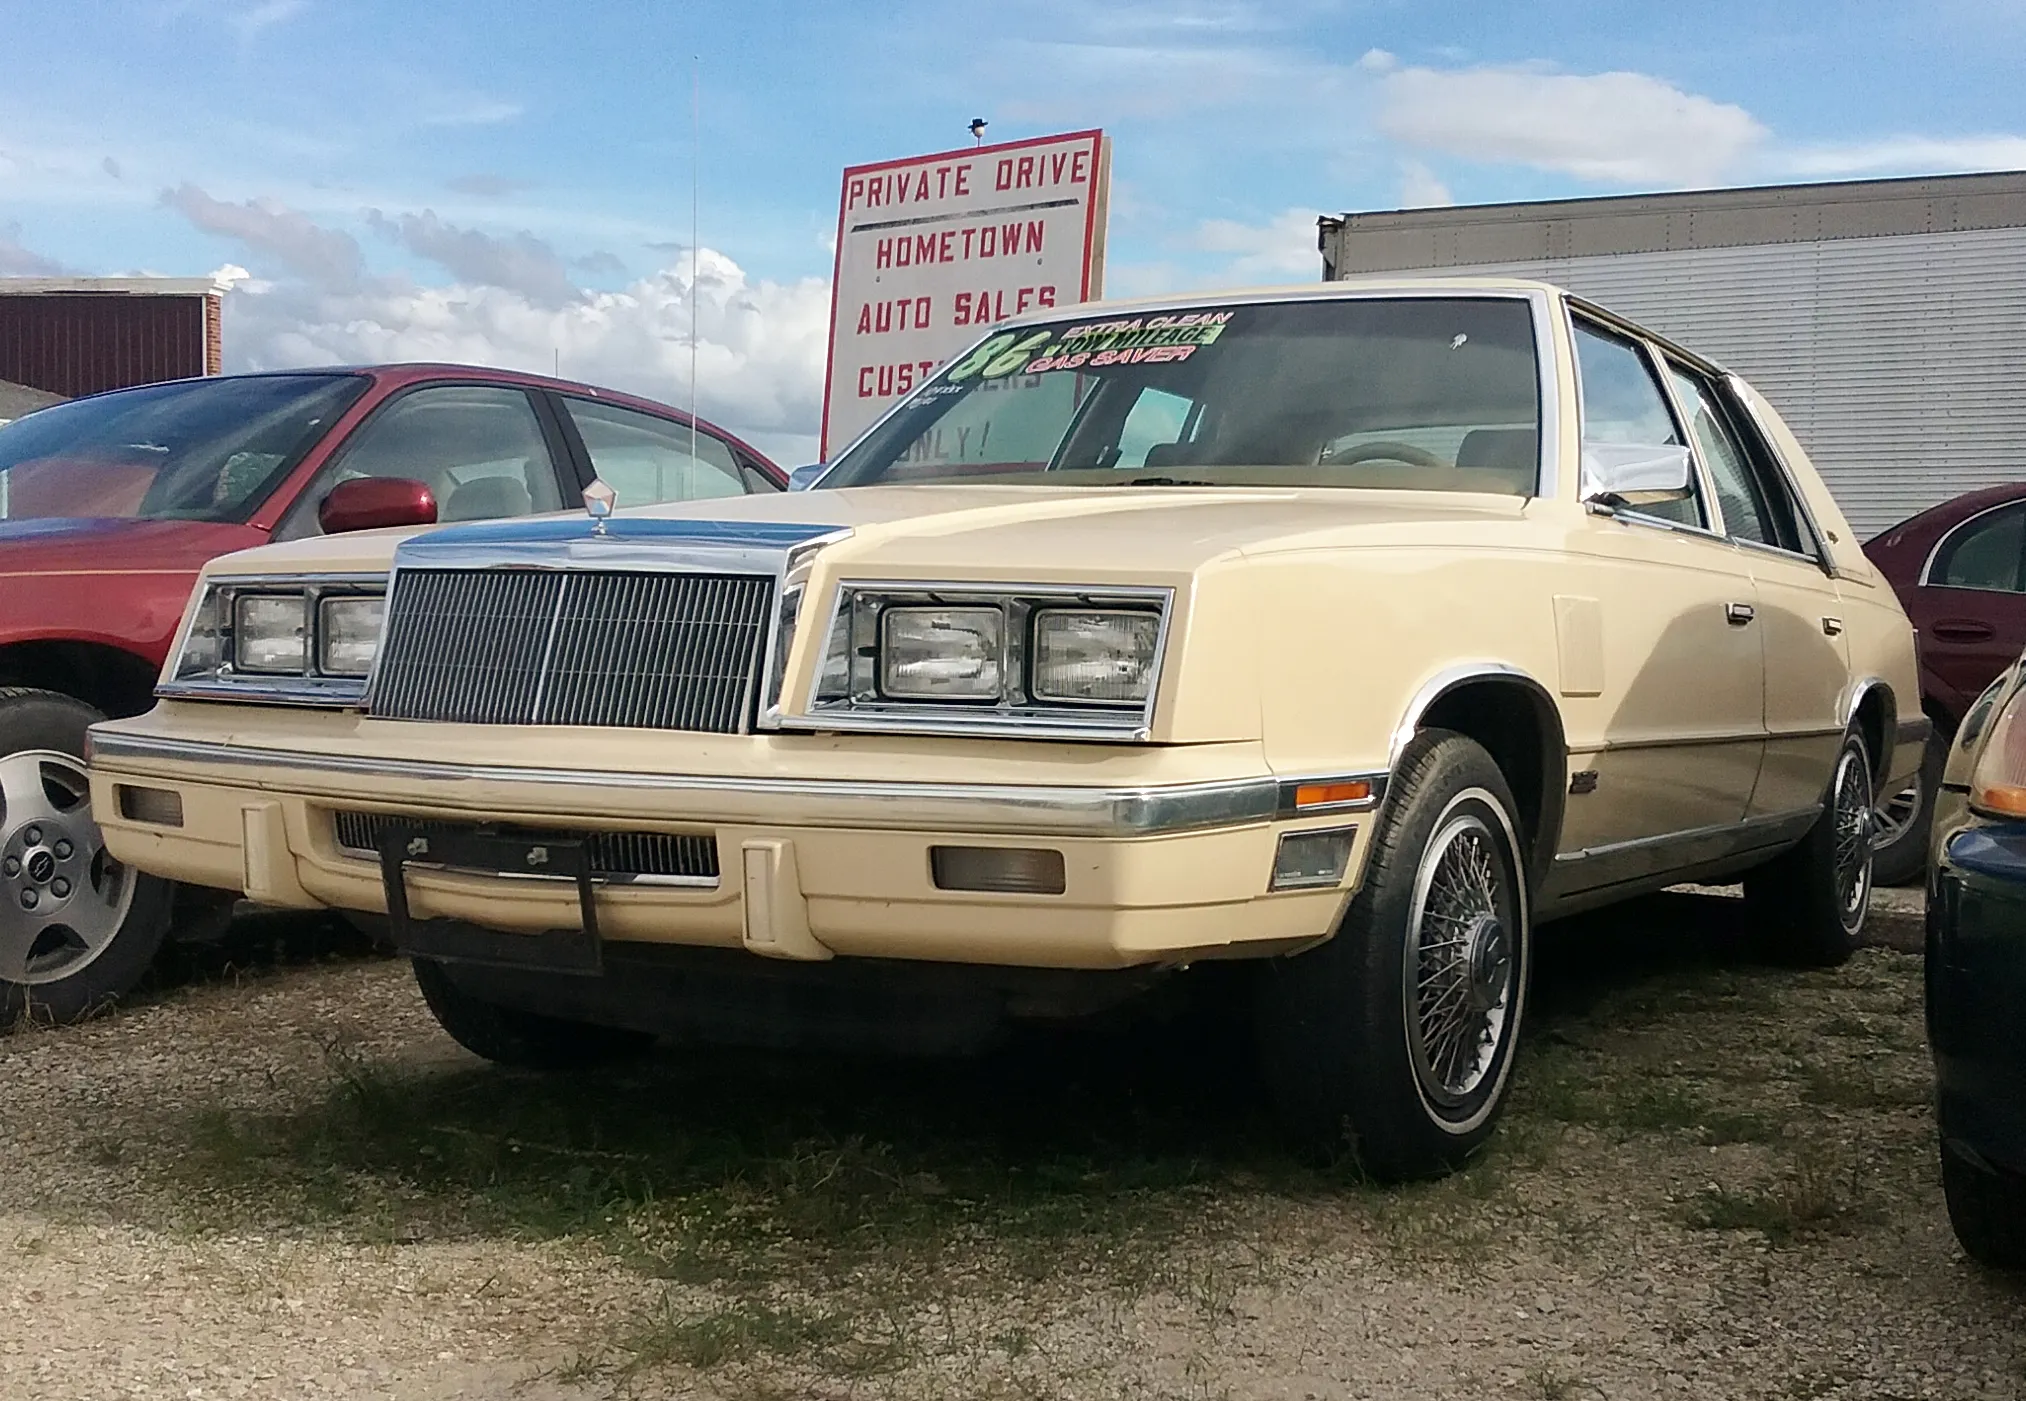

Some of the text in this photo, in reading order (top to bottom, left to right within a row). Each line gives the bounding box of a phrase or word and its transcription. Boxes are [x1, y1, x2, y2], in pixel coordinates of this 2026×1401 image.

[848, 151, 1090, 210] PRIVATE DRIVE
[876, 220, 1045, 270] HOMETOWN
[857, 286, 1056, 335] AUTO SALES
[1061, 311, 1235, 340] EXTRA CLEAN
[948, 331, 1052, 382] 86
[1025, 345, 1197, 374] GAS SAVER
[1109, 325, 1213, 350] MILEAGE
